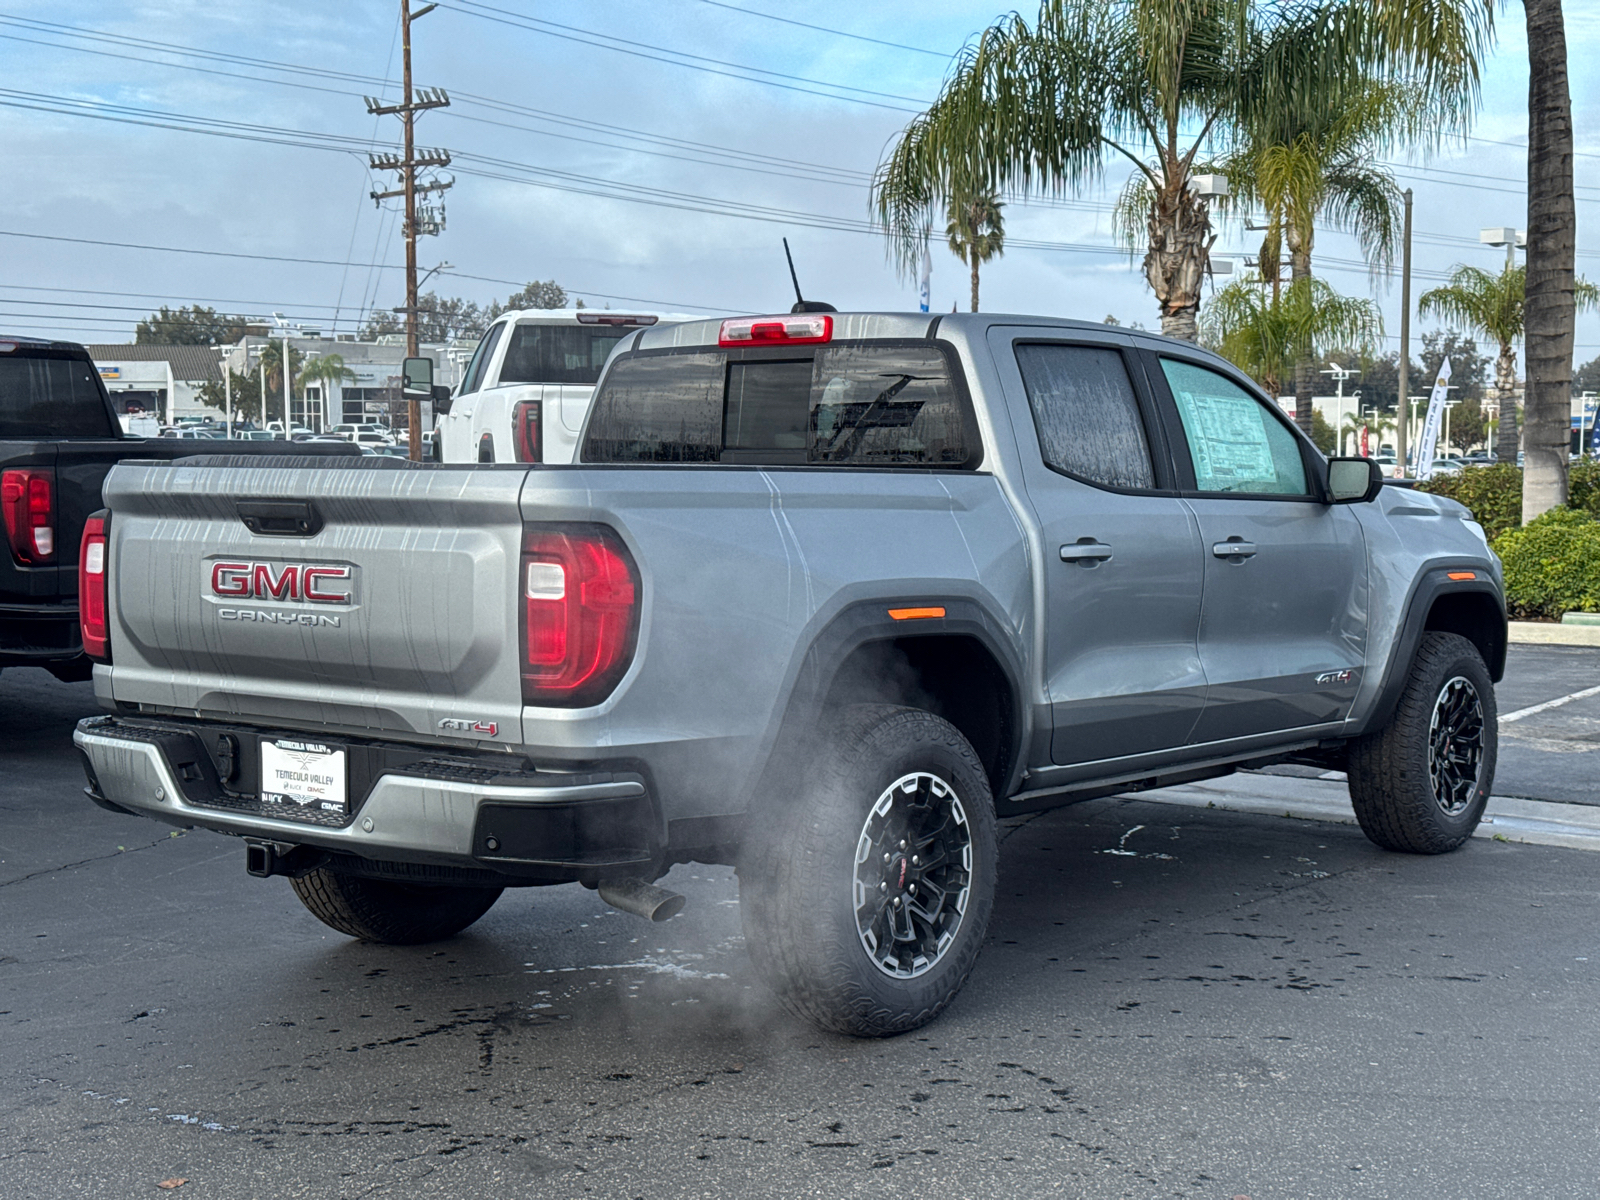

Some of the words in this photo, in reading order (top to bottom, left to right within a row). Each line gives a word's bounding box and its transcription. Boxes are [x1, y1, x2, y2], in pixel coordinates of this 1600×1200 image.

[211, 561, 351, 605] GMC
[218, 608, 341, 628] CANYON
[1314, 669, 1352, 685] AT4
[438, 717, 498, 737] AT4
[277, 740, 305, 751] TEMECULA
[305, 743, 327, 753] VALLEY
[275, 769, 309, 782] TEMECULA
[310, 774, 334, 786] VALLEY
[307, 786, 325, 794] GMC
[321, 802, 344, 813] GMC
